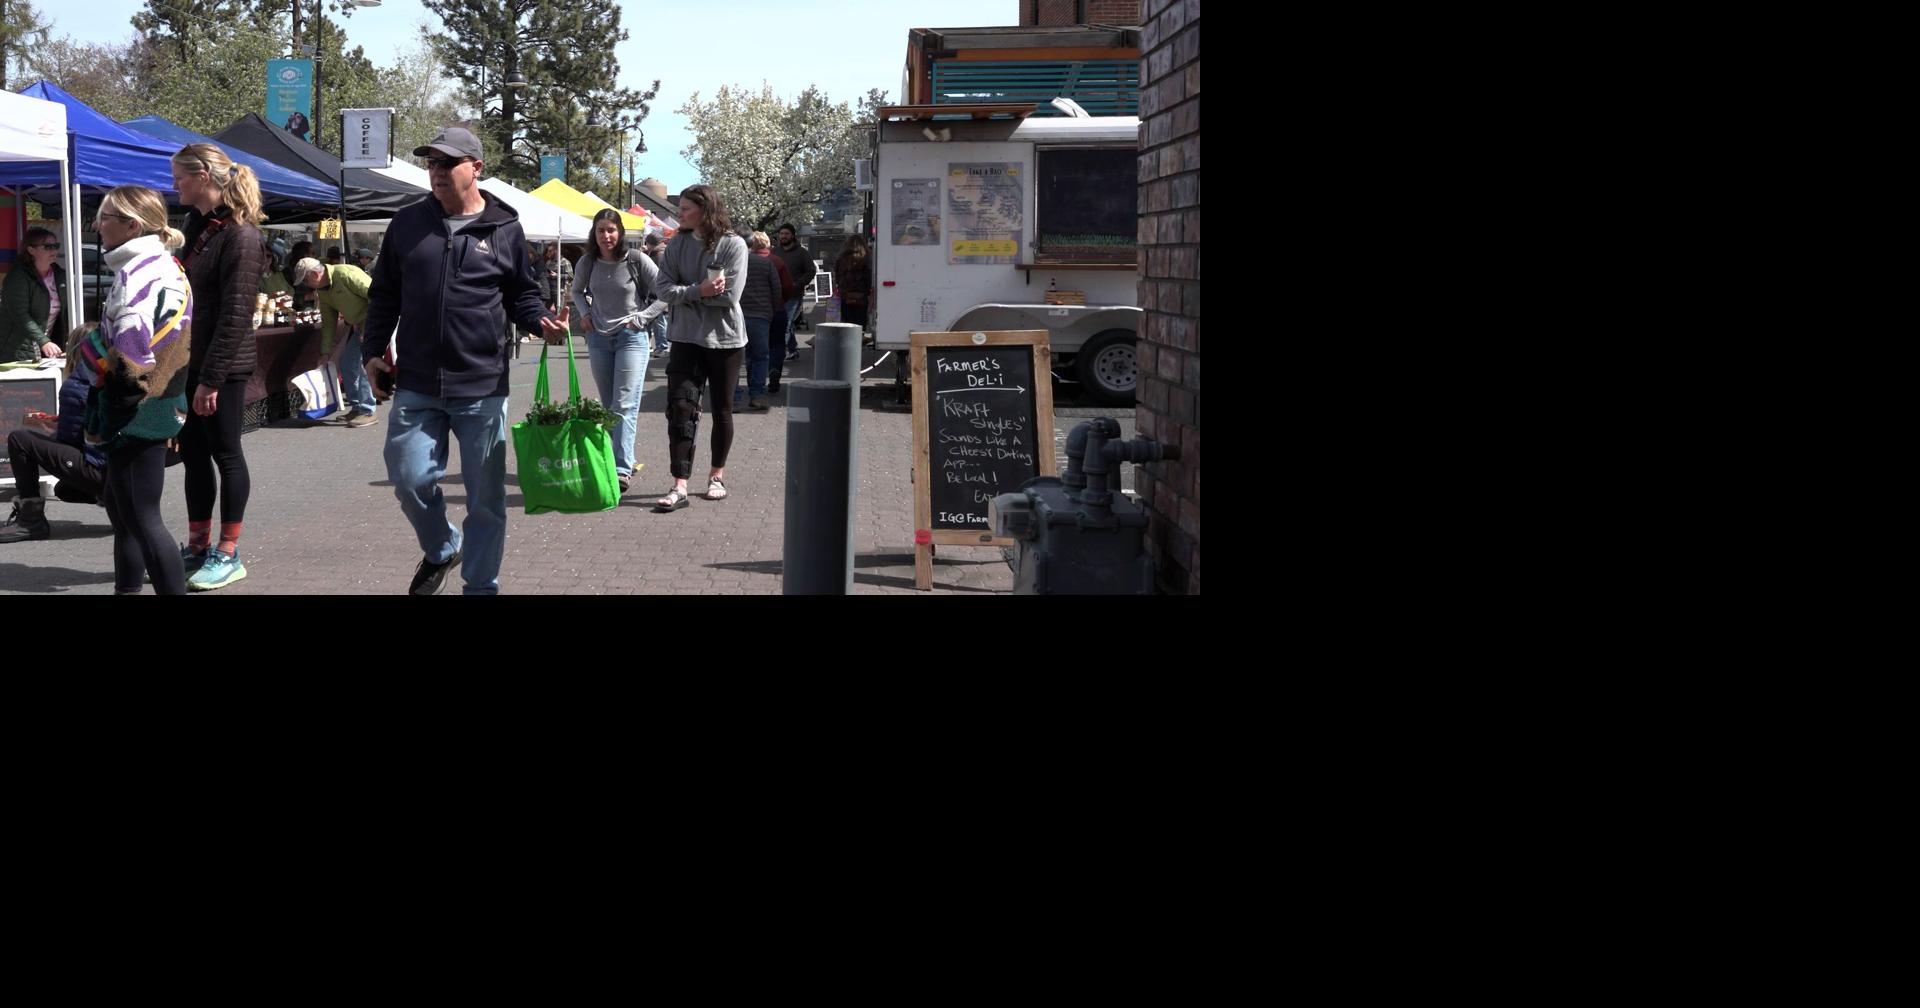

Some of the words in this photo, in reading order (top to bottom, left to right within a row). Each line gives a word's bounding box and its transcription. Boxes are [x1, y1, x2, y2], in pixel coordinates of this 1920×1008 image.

[361, 117, 370, 155] COFFEE
[936, 356, 1001, 373] FARMER'S
[1013, 435, 1022, 446] A
